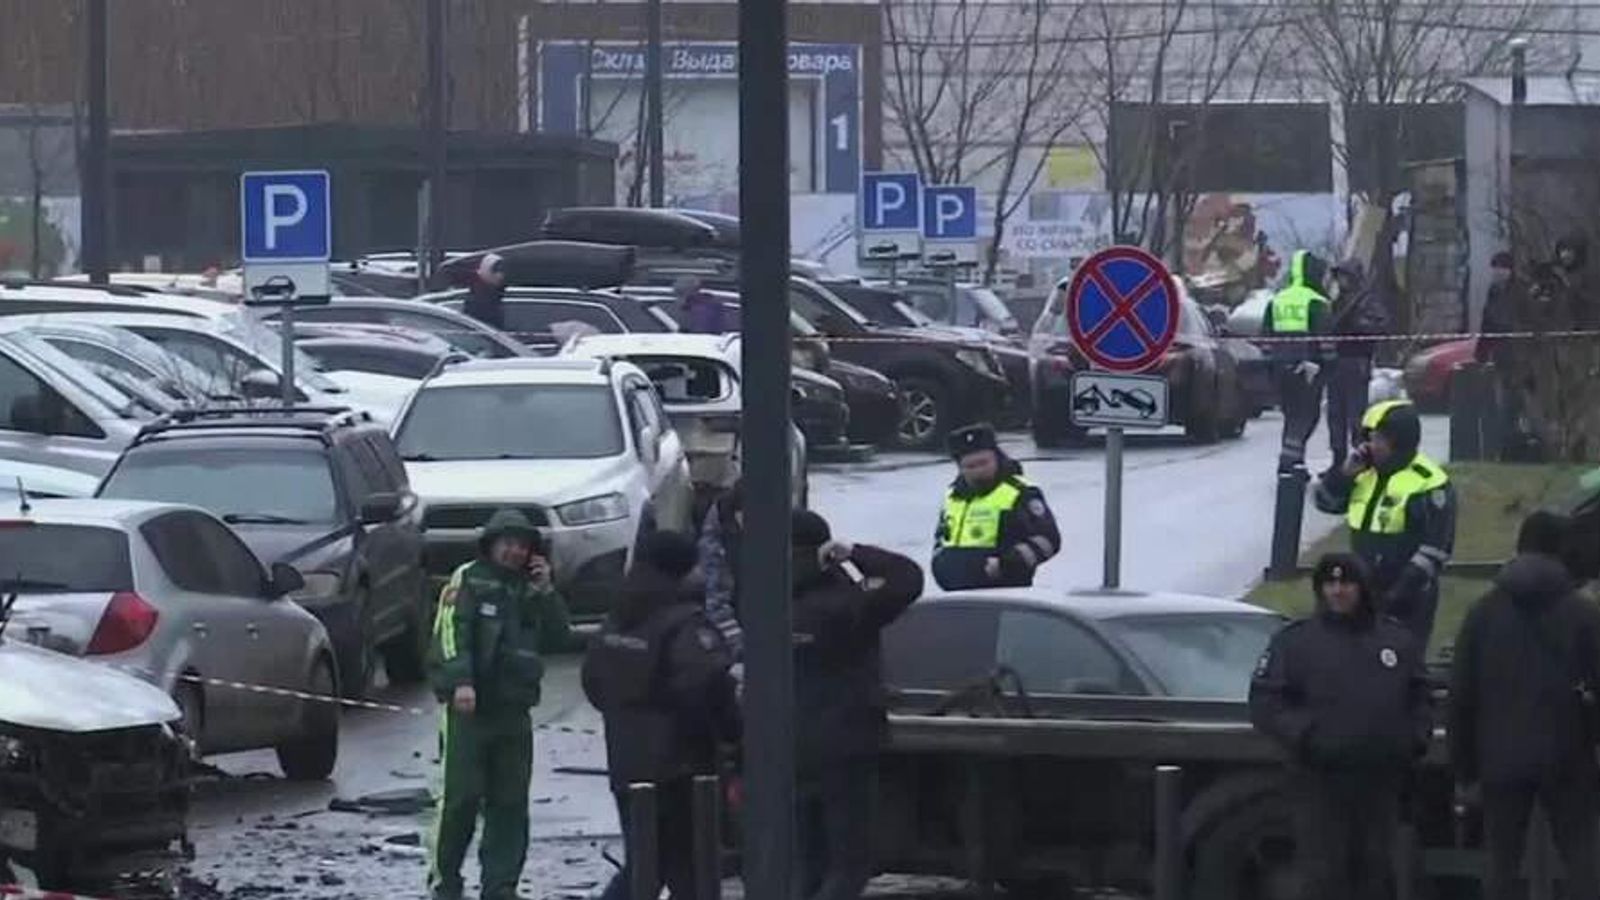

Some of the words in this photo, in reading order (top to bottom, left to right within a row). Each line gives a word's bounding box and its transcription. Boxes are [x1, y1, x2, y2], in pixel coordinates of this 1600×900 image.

[592, 48, 645, 71] Скла
[672, 49, 736, 73] Выда
[787, 54, 852, 74] овара
[831, 113, 848, 150] 1
[264, 184, 308, 250] P
[876, 182, 905, 226] P
[936, 194, 964, 236] P
